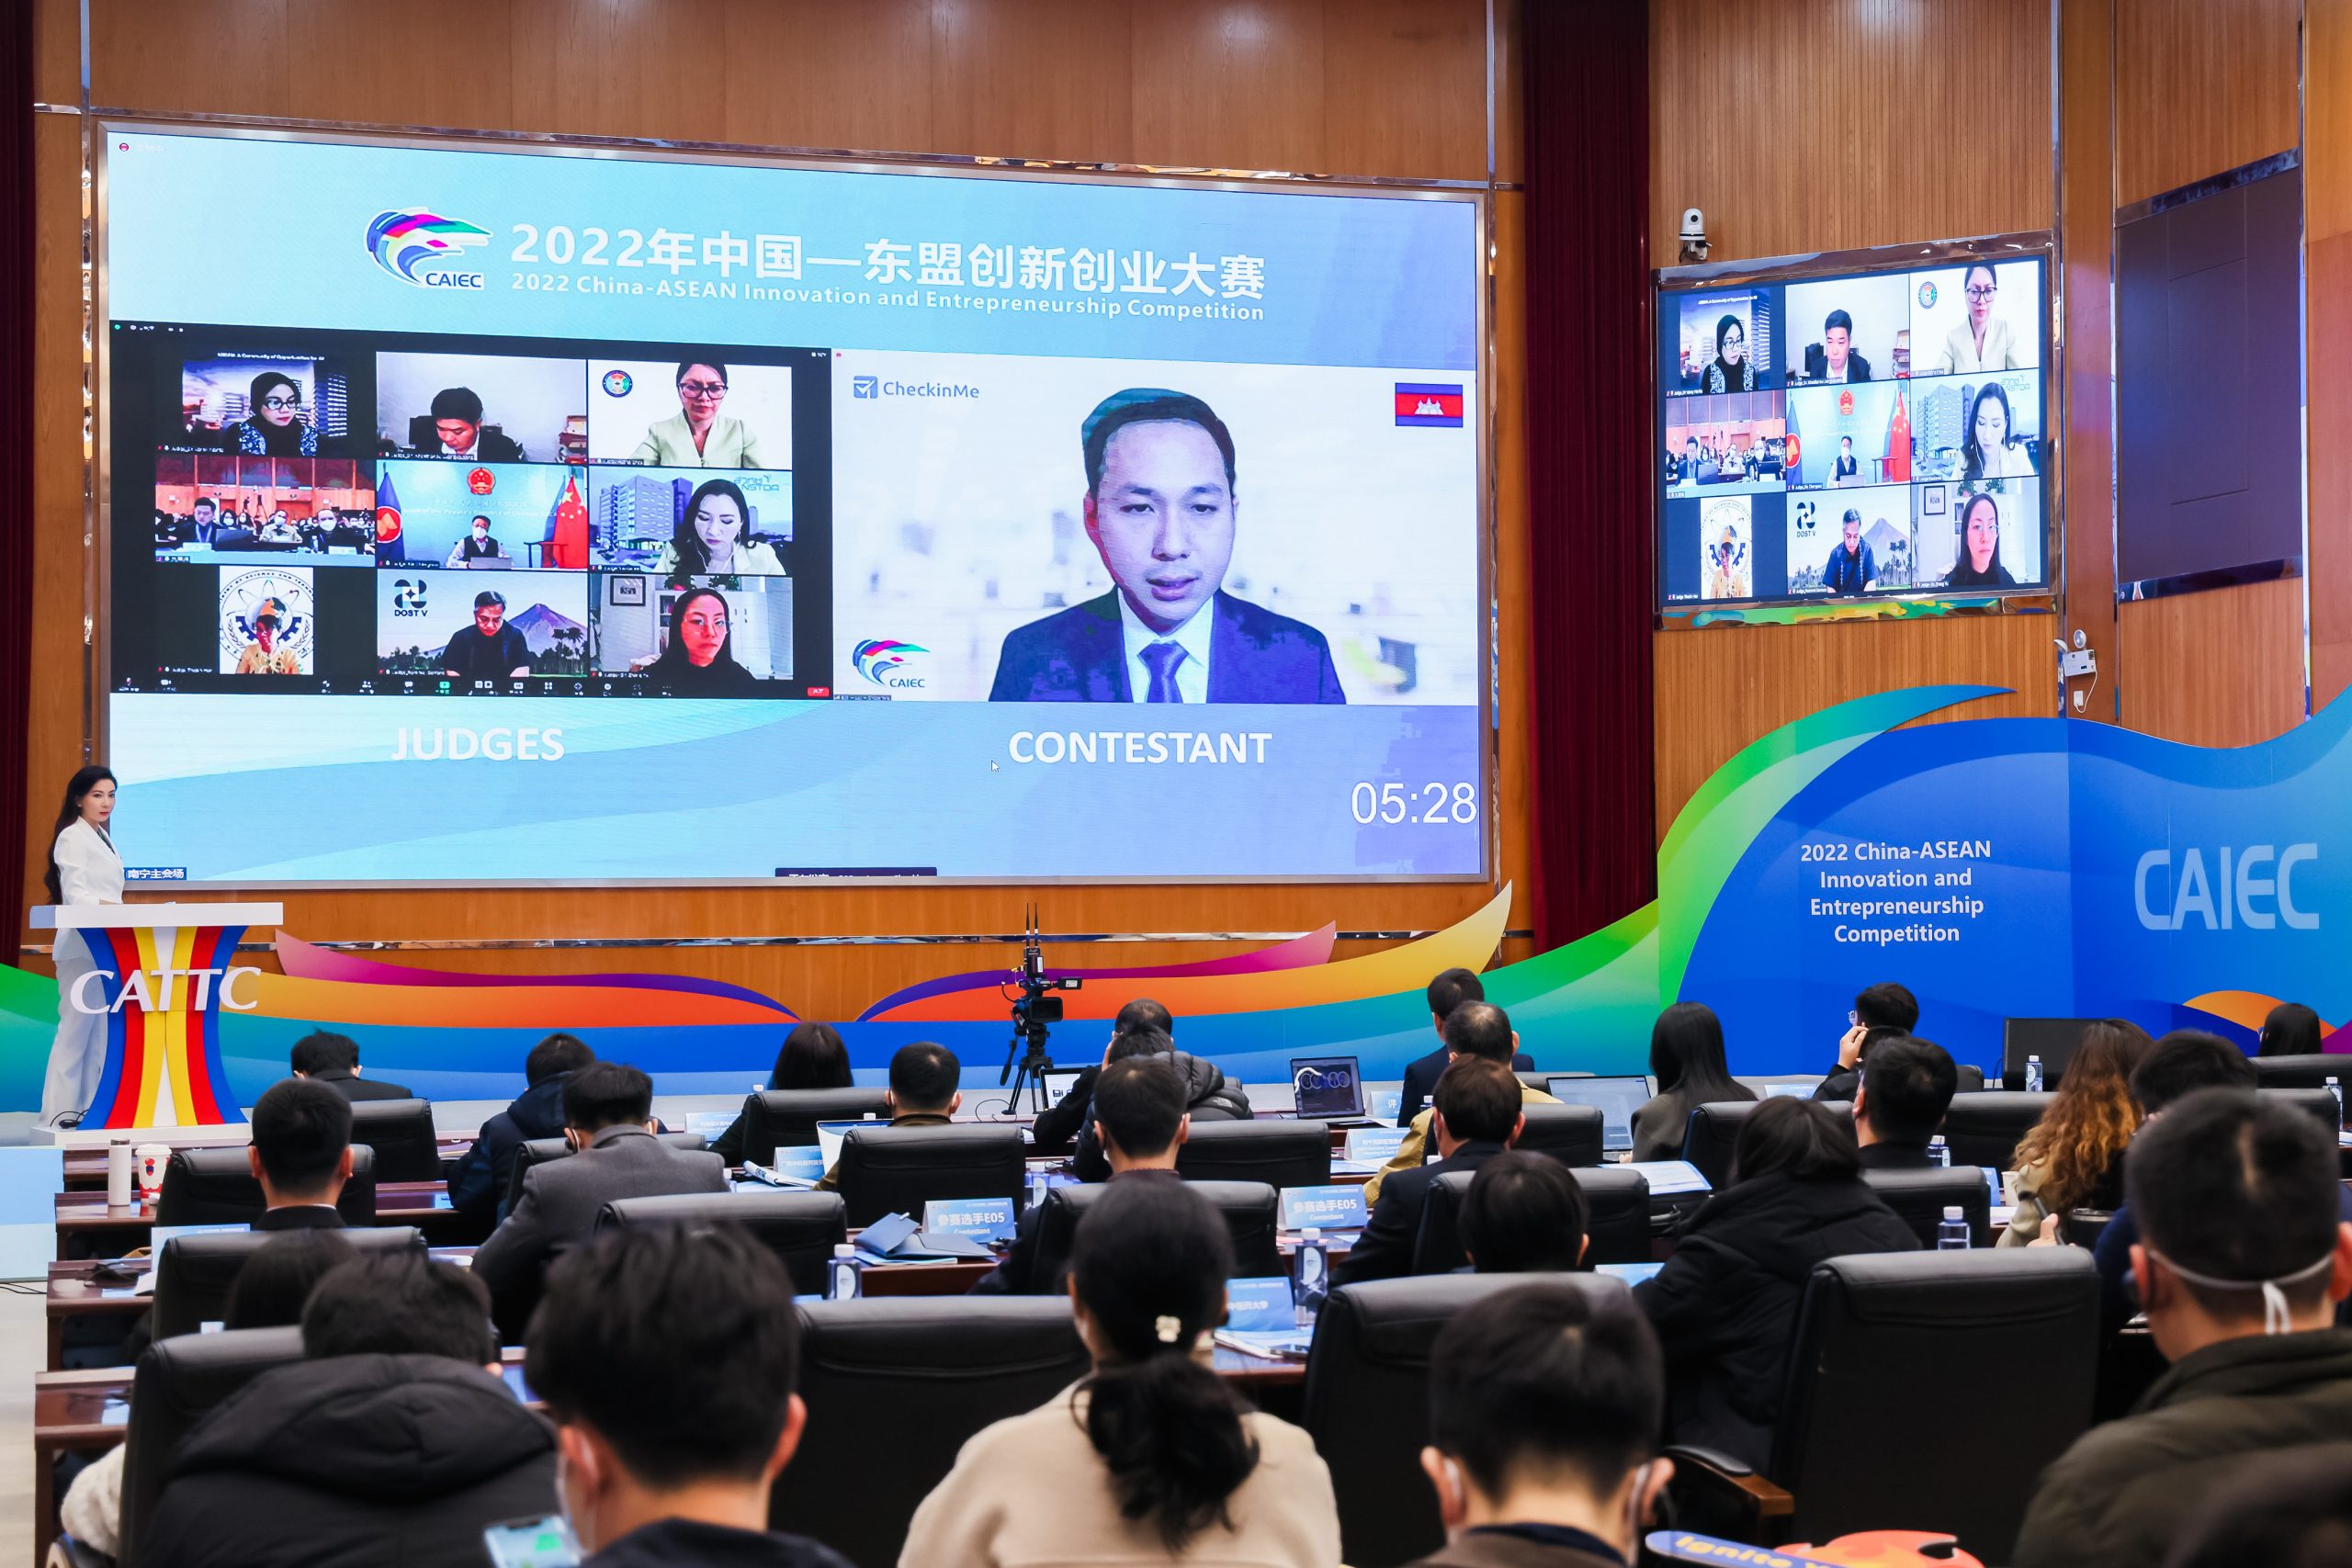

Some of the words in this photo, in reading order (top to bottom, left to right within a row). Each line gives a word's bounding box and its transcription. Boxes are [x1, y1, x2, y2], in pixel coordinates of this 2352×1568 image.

[425, 272, 482, 288] CAIEC
[511, 272, 570, 292] 2022
[576, 275, 737, 299] China-ASEAN
[744, 281, 871, 305] Innovation
[877, 288, 919, 308] and
[926, 291, 1121, 317] Entrepreneurship
[1127, 298, 1265, 322] Competition
[883, 381, 979, 398] CheckinMe
[889, 678, 925, 688] CAIEC
[391, 727, 565, 761] JUDGES
[1009, 731, 1272, 764] CONTESTANT
[1351, 782, 1478, 824] 05:28
[1801, 843, 1849, 862] 2022
[1854, 840, 1991, 861] China-ASEAN
[127, 868, 185, 879] 南宁主会场
[1820, 869, 1928, 888] Innovation
[1934, 868, 1972, 886] and
[2134, 842, 2320, 931] CAIEC
[1810, 896, 1984, 919] Entrepreneurship
[1834, 923, 1960, 947] Competition
[70, 966, 262, 1014] CATTC
[1675, 1535, 1792, 1568] Ignite
